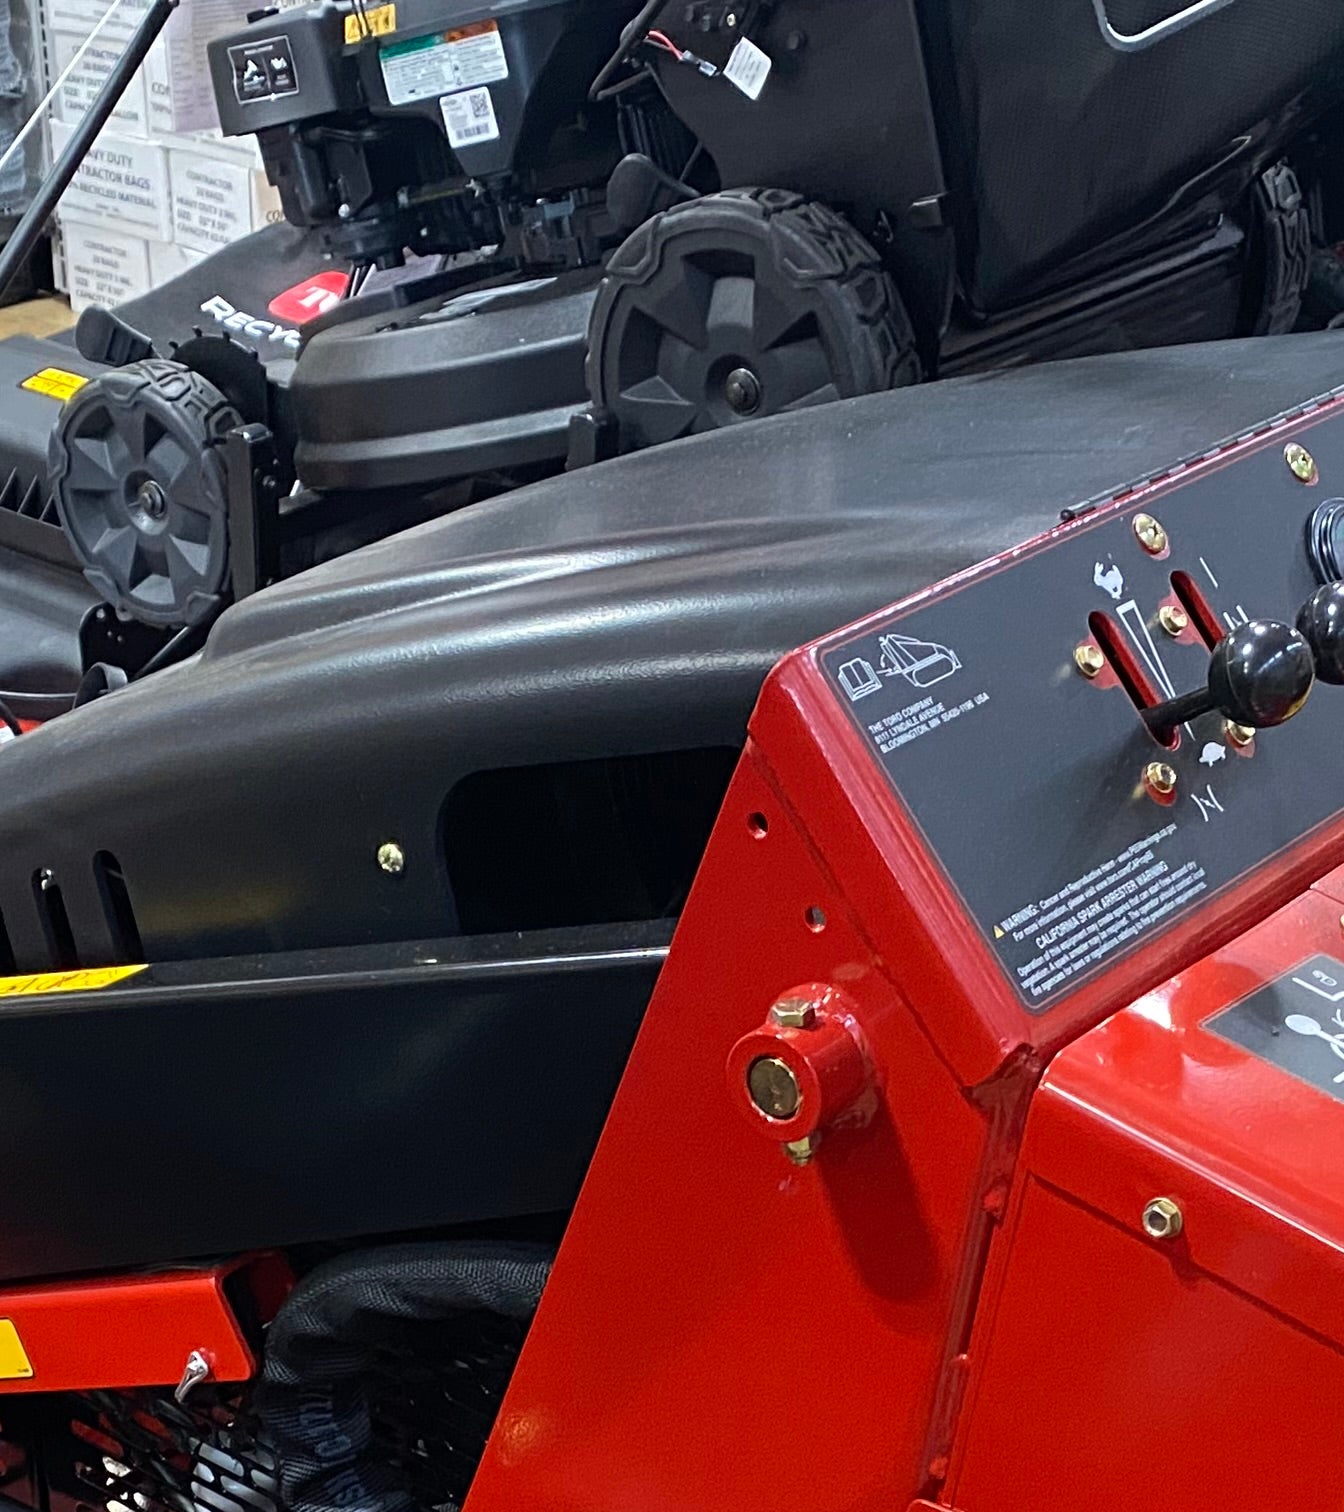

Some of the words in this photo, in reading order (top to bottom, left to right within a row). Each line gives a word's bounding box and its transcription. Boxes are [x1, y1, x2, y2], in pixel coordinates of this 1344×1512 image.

[106, 151, 133, 169] DUTY
[77, 164, 122, 183] TRACTOR
[124, 174, 151, 191] BAGS
[266, 209, 284, 223] CO
[200, 295, 303, 349] RECYC
[882, 712, 903, 726] TORO
[1036, 916, 1080, 949] CALIFORNIA
[1077, 901, 1104, 923] SPARK
[1101, 880, 1138, 909] ARRESTER
[1135, 860, 1168, 886] WARNING
[1012, 931, 1024, 942] For
